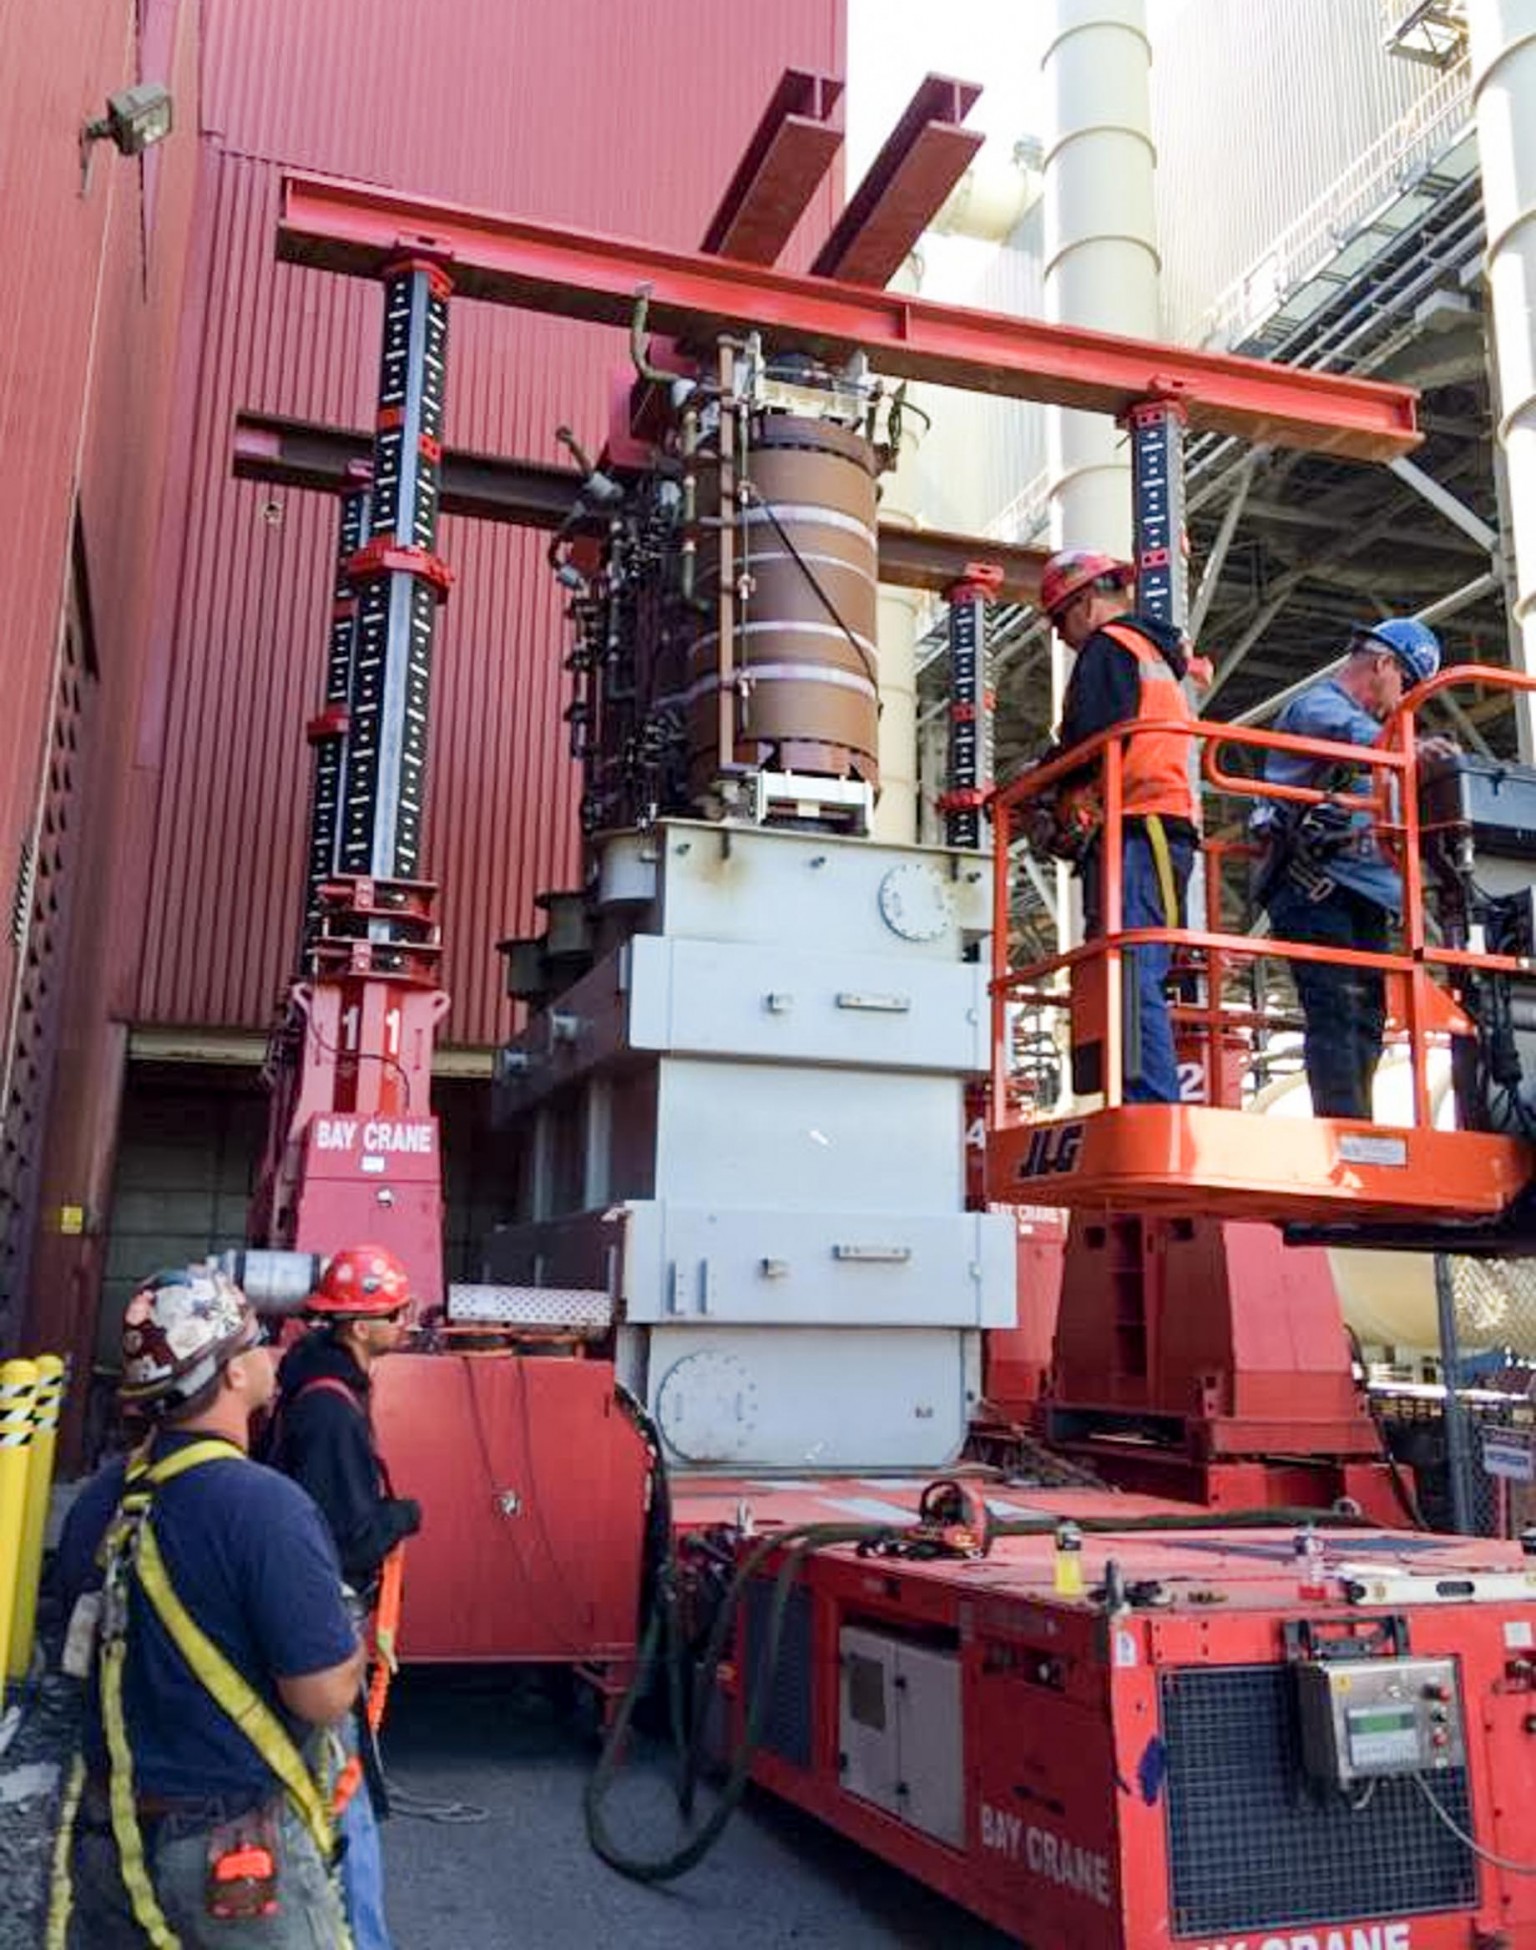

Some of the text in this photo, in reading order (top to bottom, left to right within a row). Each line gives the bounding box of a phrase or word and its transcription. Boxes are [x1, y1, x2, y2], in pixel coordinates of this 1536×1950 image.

[342, 1004, 401, 1055] 1 1
[1176, 1061, 1206, 1102] 2
[317, 1120, 432, 1153] BAY CRANE
[981, 1804, 1112, 1907] BAY CRANE
[1261, 1923, 1411, 1950] ANE
